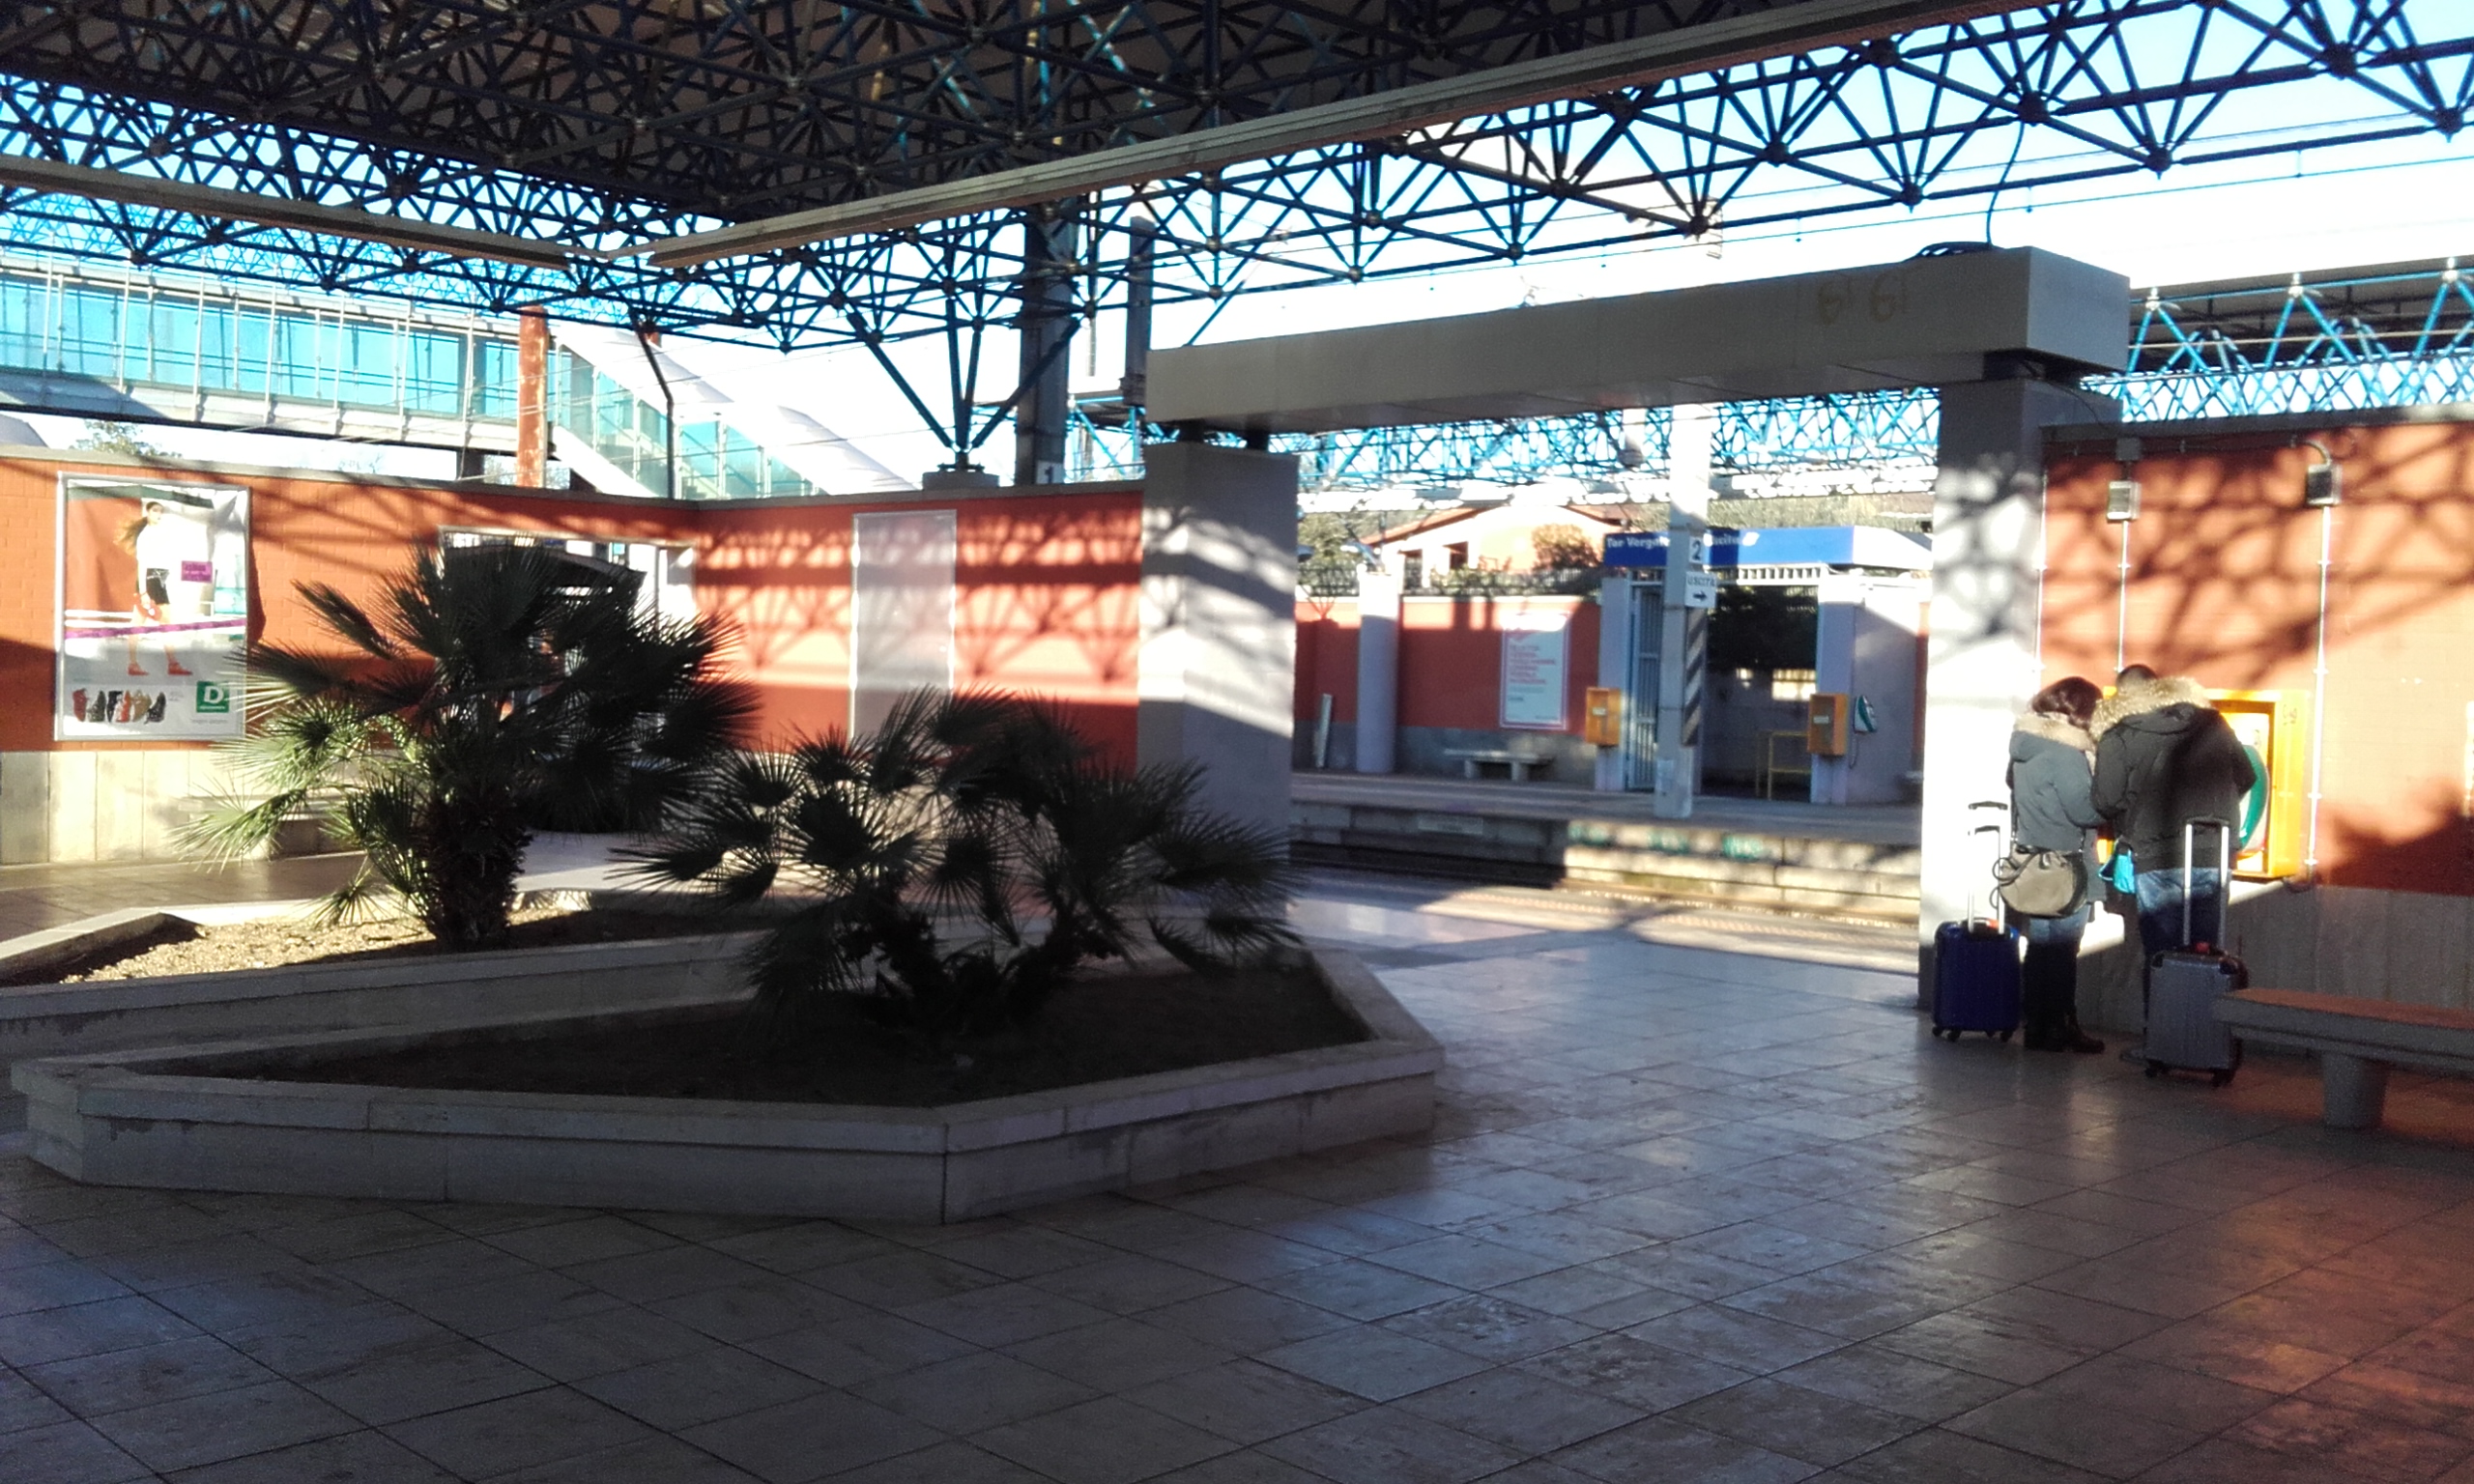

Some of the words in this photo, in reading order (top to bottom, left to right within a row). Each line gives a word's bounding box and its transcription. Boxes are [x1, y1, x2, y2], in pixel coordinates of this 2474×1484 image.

[1626, 536, 1670, 550] Verga
[1691, 539, 1702, 560] 2
[203, 685, 224, 704] D
